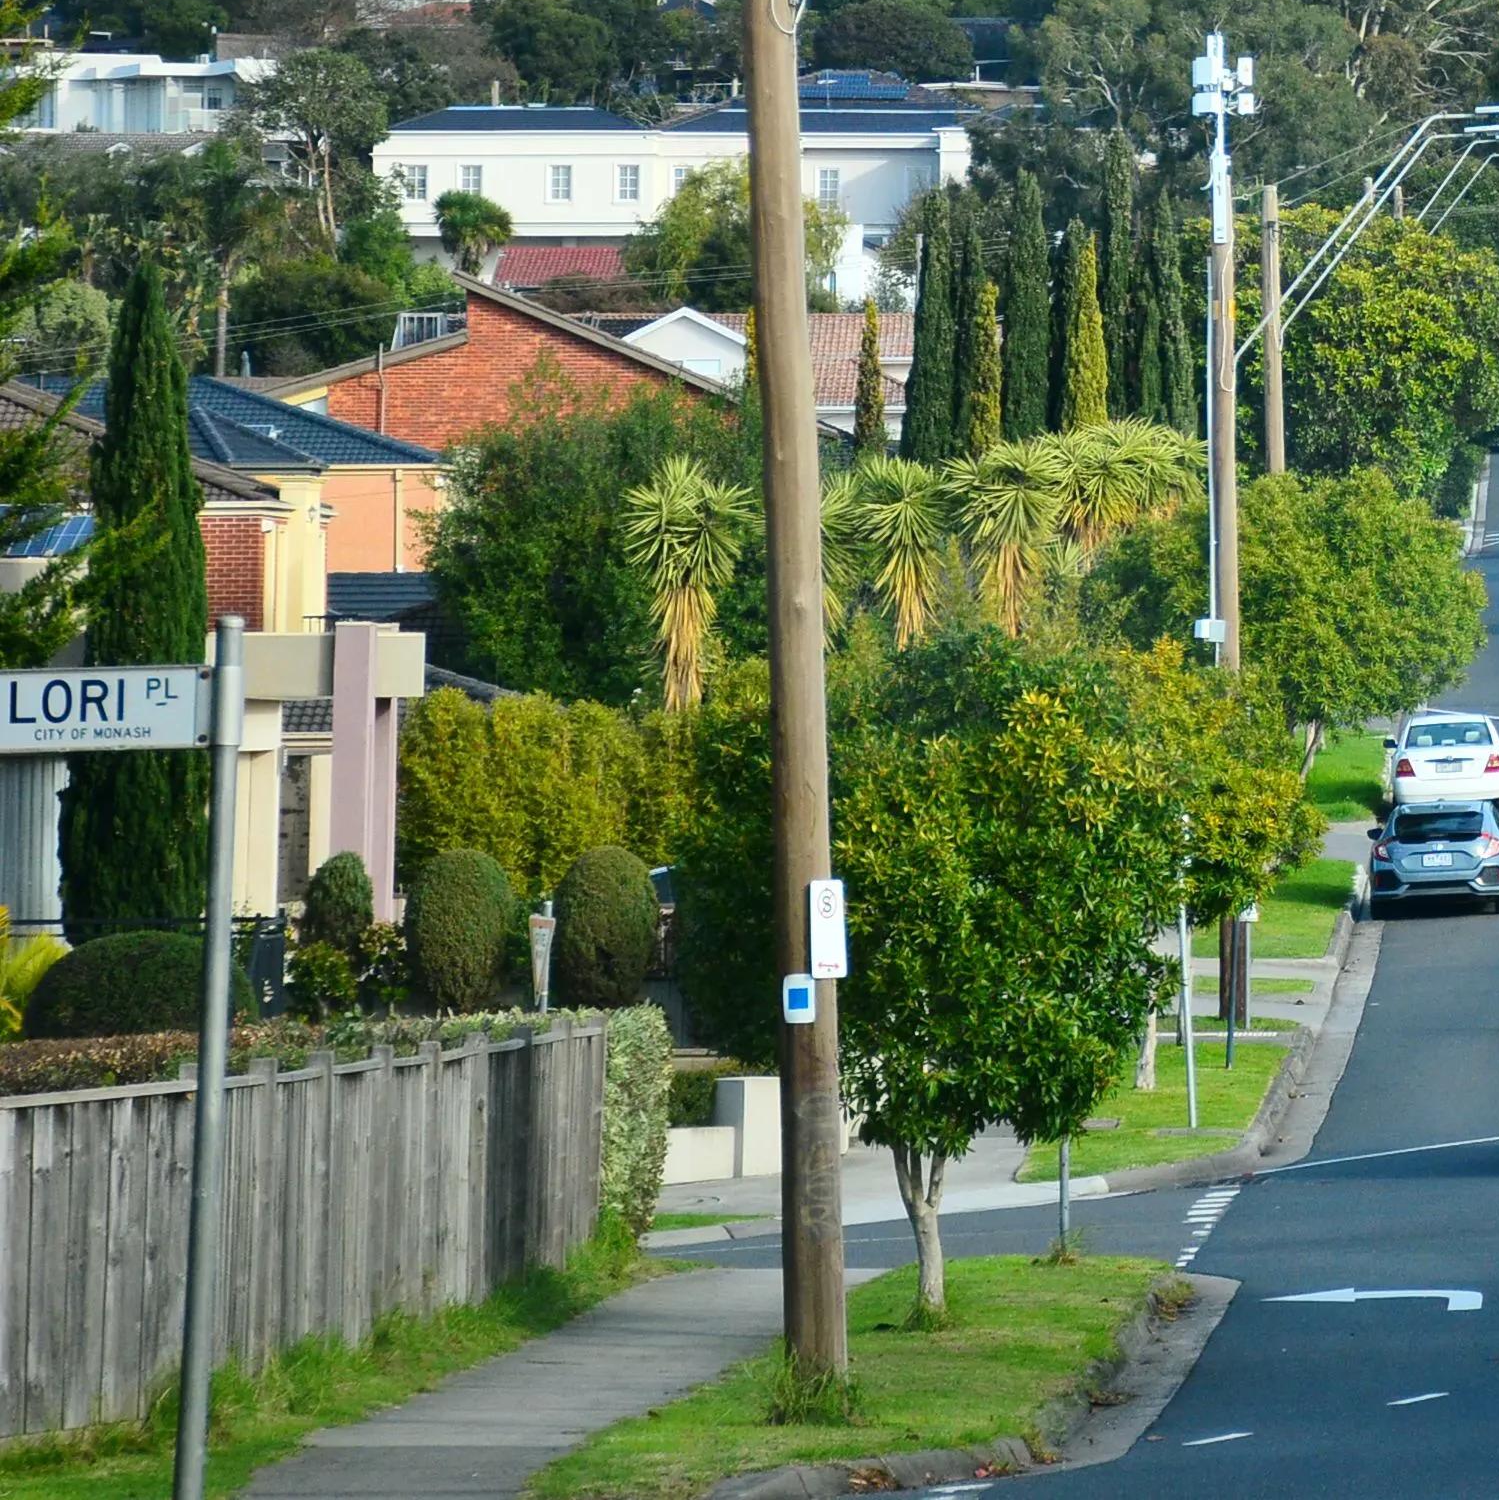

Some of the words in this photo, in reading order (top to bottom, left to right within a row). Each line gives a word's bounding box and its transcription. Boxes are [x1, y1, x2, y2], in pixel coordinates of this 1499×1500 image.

[9, 678, 125, 724] LORI
[145, 678, 178, 700] PL
[34, 729, 66, 741] CITY
[71, 728, 87, 740] OF
[93, 726, 152, 740] MONASH
